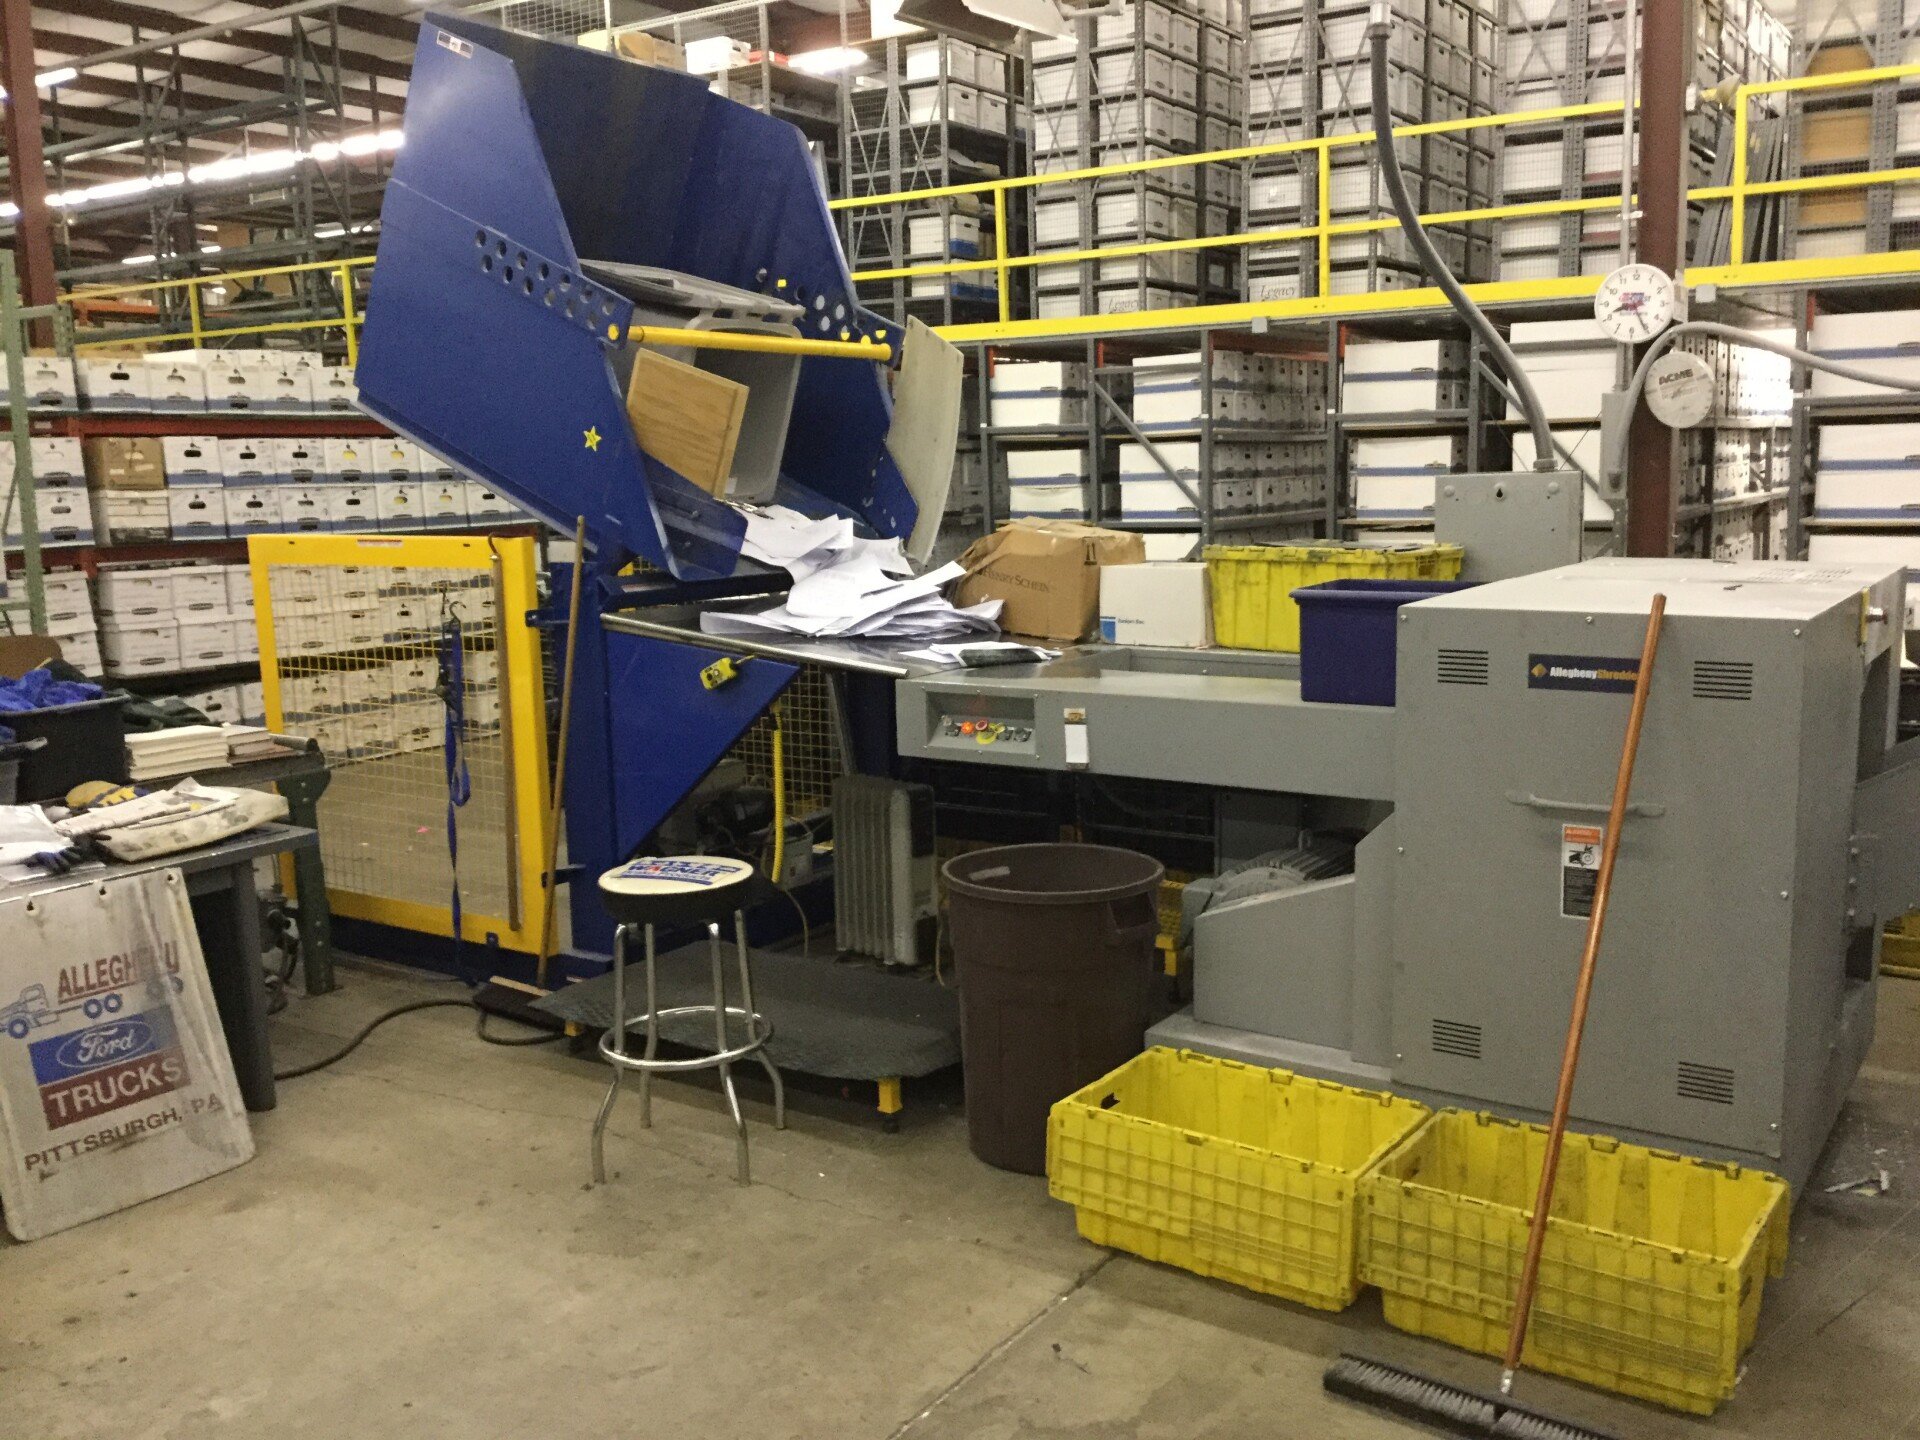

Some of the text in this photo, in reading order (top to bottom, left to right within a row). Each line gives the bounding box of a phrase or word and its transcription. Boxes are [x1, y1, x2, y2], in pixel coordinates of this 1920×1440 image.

[1658, 368, 1694, 386] ACME
[78, 1029, 137, 1063] Ford
[47, 1056, 183, 1119] TRUCKS
[24, 1107, 184, 1171] PITTSBURGH,
